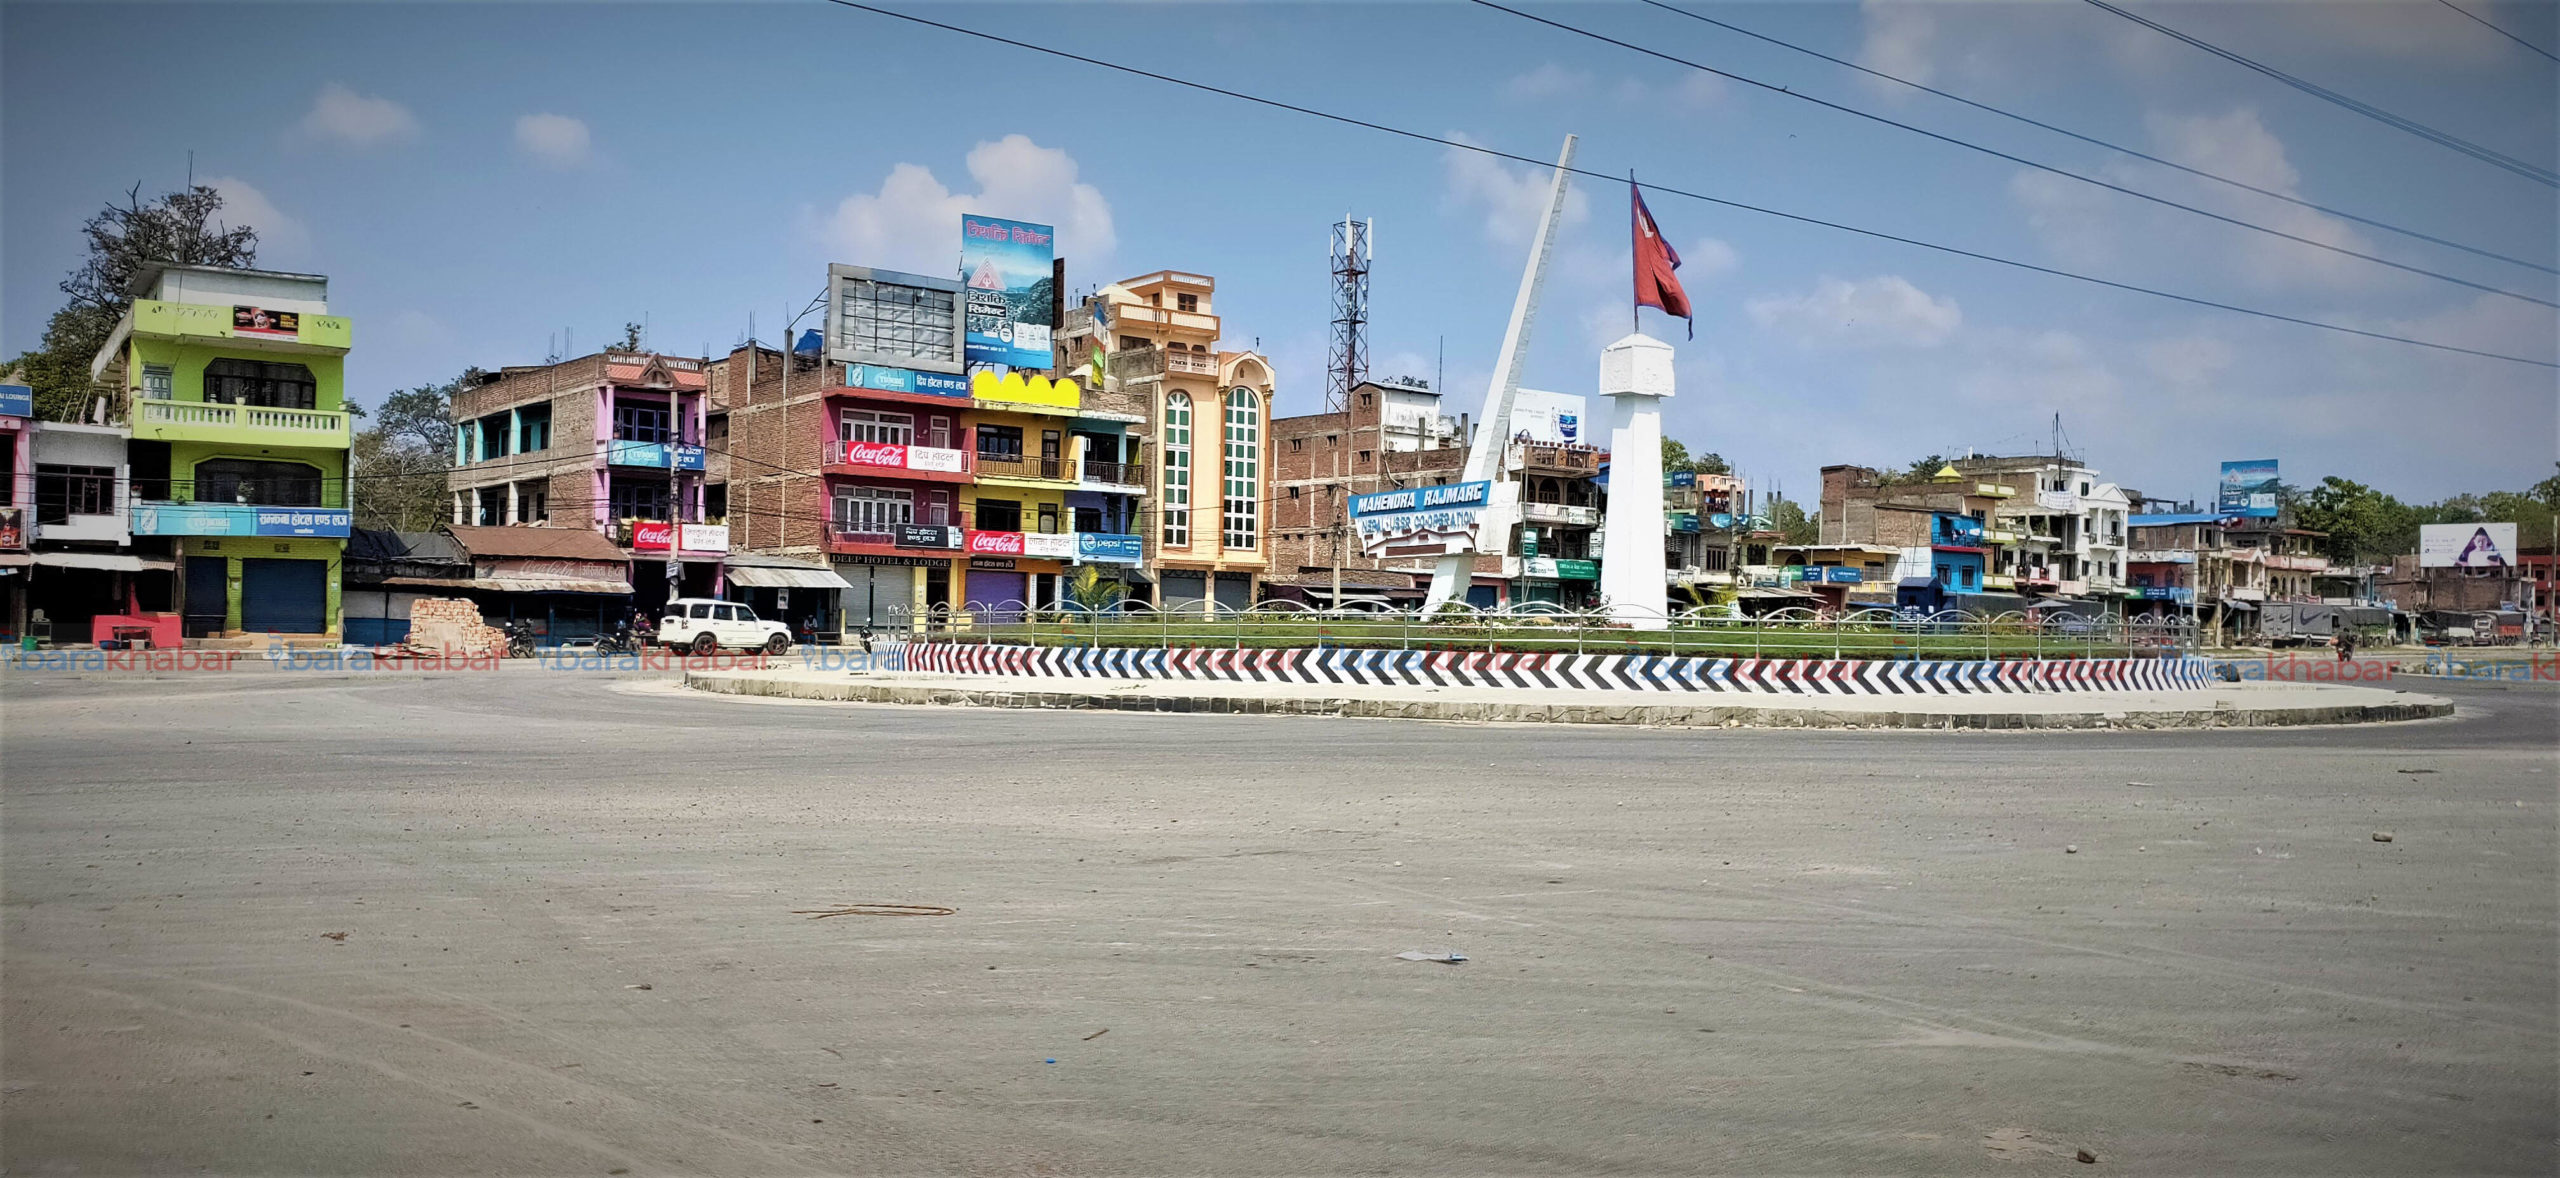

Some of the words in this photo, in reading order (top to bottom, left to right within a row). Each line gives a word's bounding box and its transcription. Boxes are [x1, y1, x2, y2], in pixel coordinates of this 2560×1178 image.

[967, 290, 1006, 304] त्रिशक्ति
[968, 303, 1005, 316] सिमेन्ट
[928, 376, 942, 388] होटल
[850, 443, 904, 466] Coca-Cola
[1357, 492, 1416, 513] MAHENDRA
[1423, 483, 1484, 506] RAJMARG
[291, 511, 313, 526] होटल
[314, 514, 331, 526] एण्ड
[332, 514, 348, 526] लज
[972, 533, 1023, 552] Coca-Cola
[1097, 540, 1120, 549] pepsi
[832, 554, 862, 563] DEEP
[864, 556, 901, 565] HOTEL
[903, 558, 911, 566] &
[913, 559, 950, 567] LODGE
